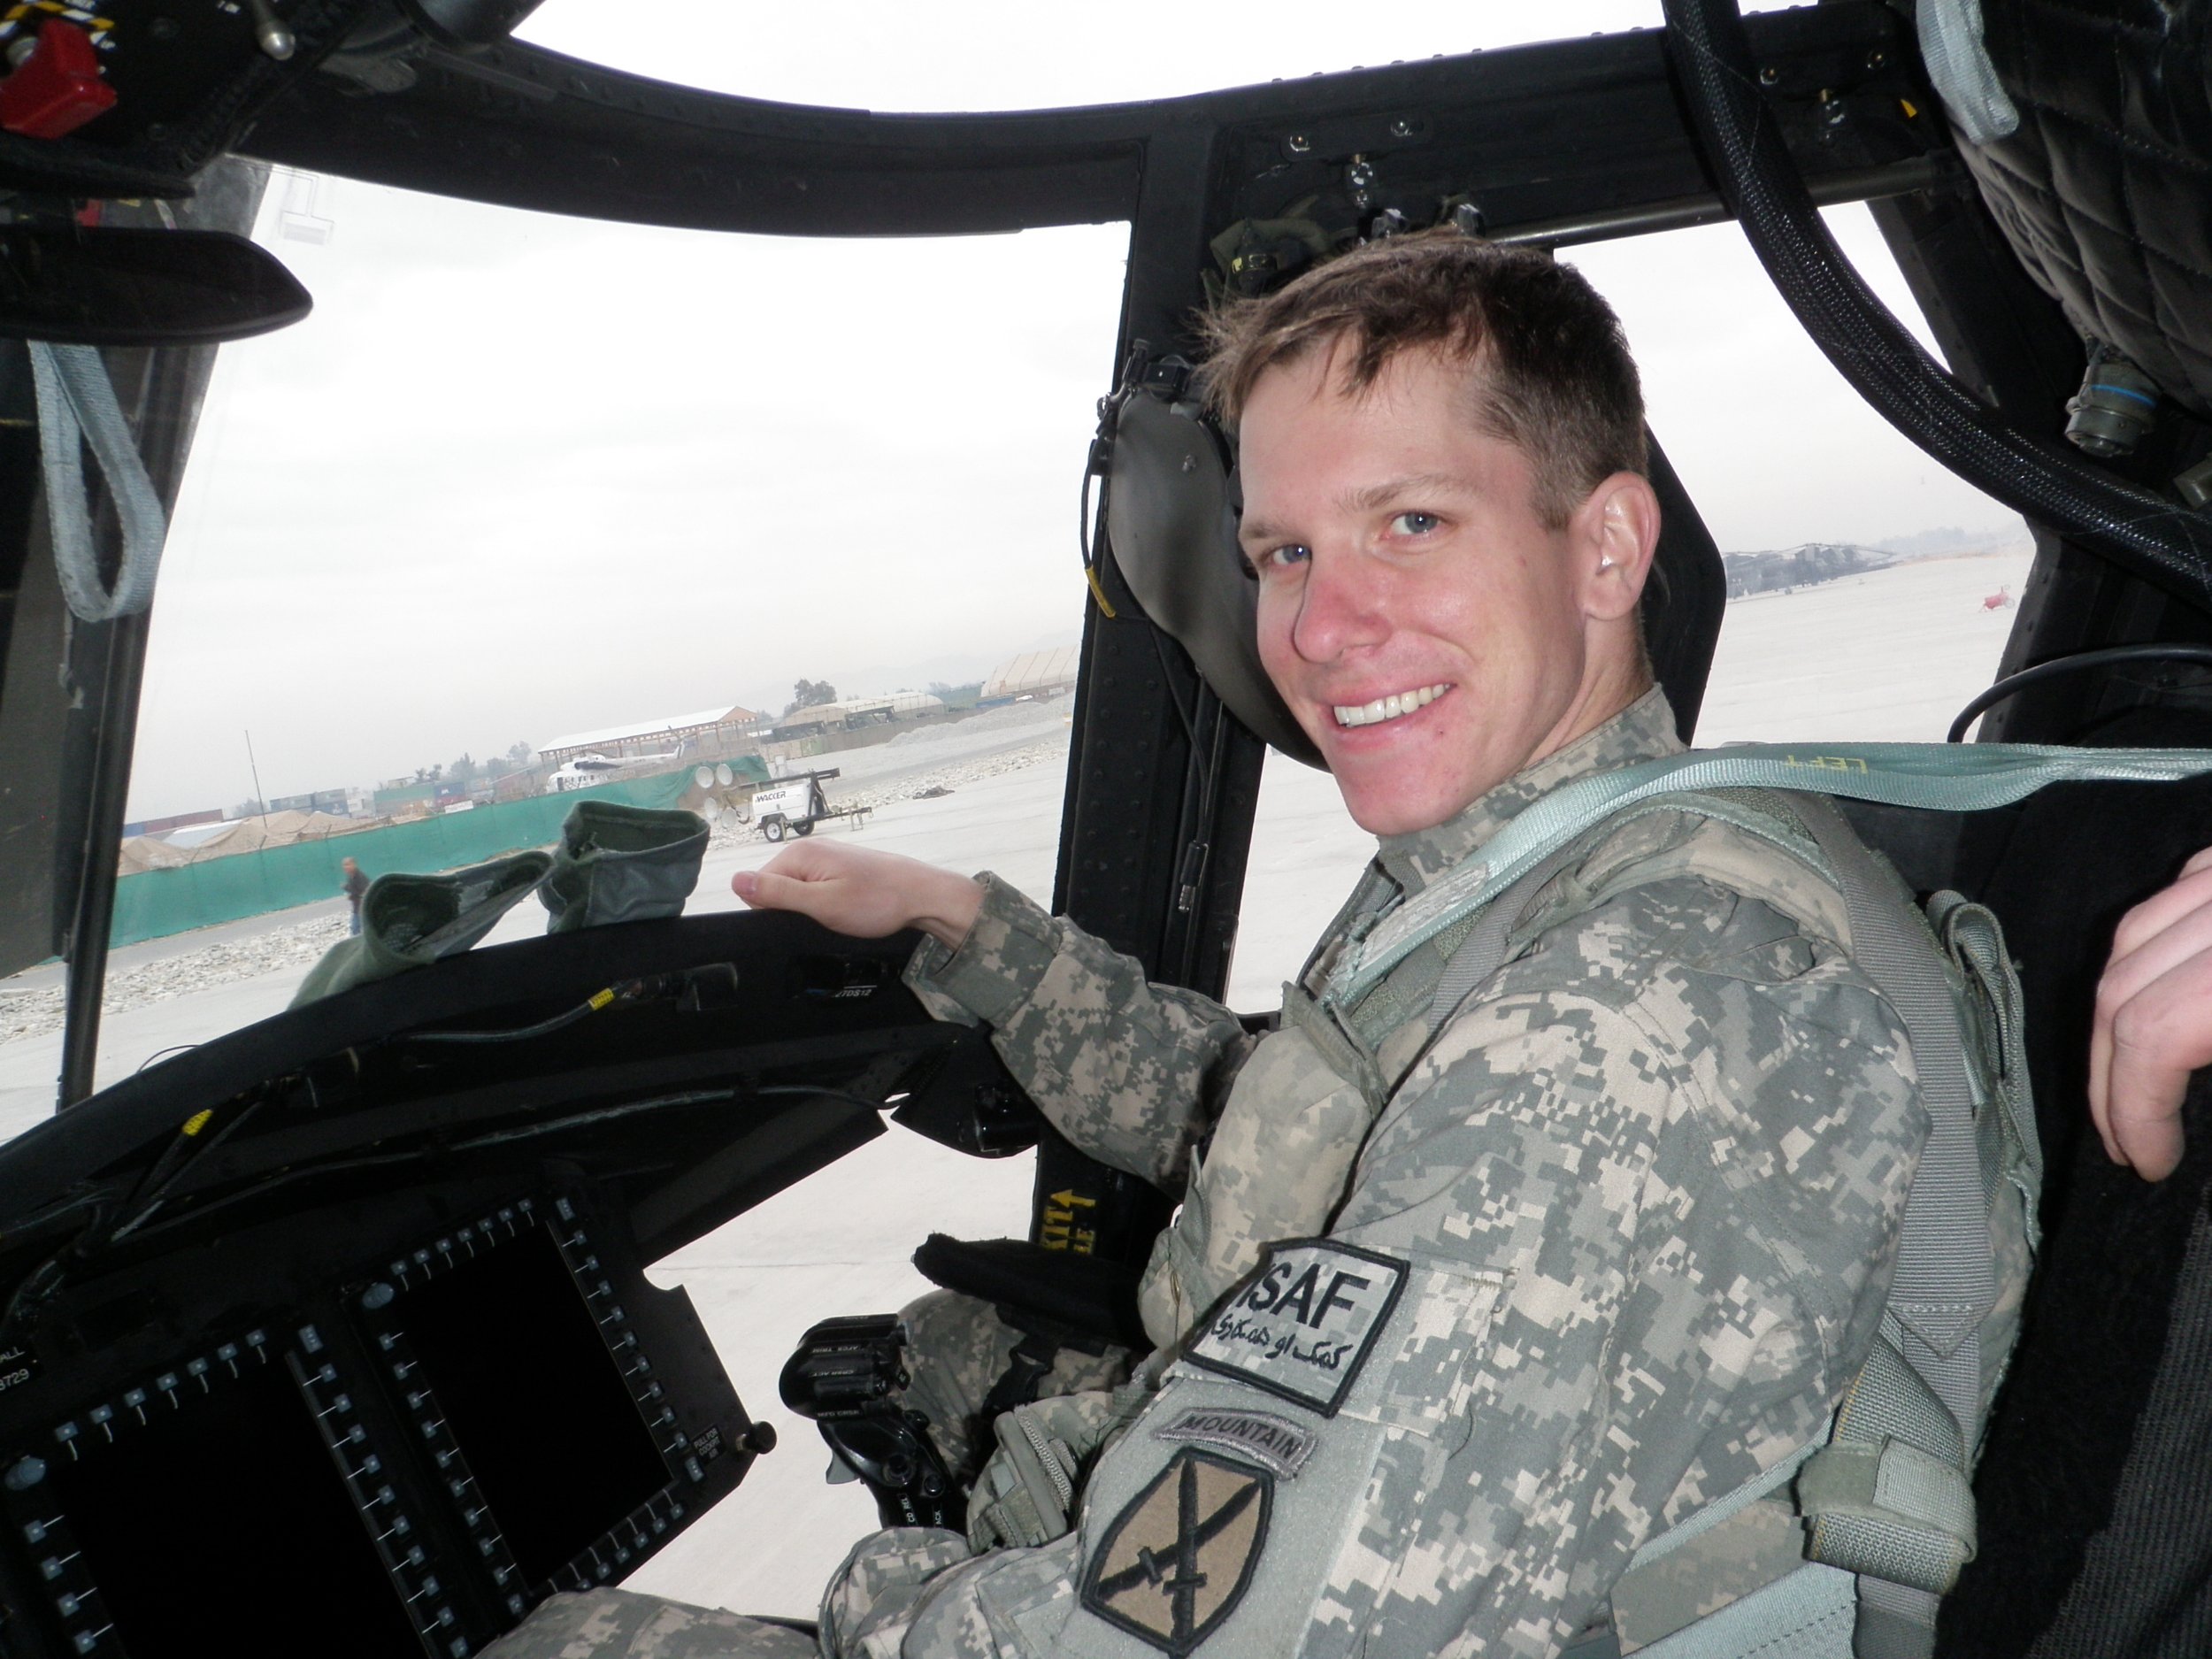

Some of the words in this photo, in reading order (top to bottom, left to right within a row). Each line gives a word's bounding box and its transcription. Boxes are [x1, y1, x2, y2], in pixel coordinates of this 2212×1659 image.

[1783, 755, 1869, 775] LEFT
[705, 1427, 718, 1440] FOR
[1176, 1415, 1303, 1459] MOUNTAIN
